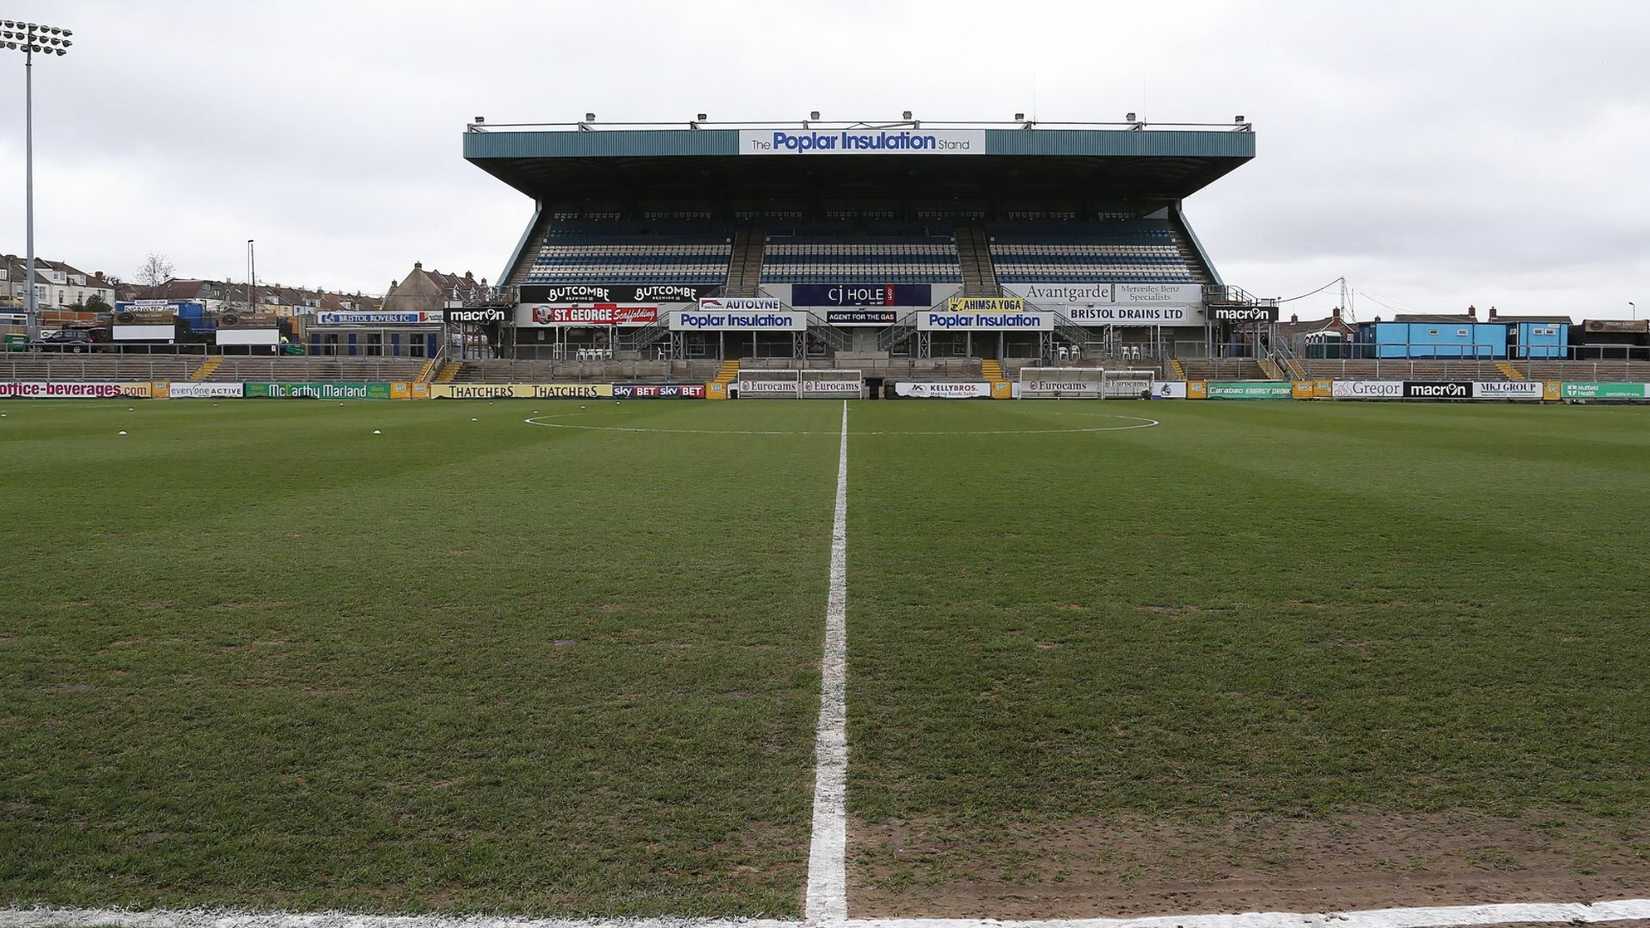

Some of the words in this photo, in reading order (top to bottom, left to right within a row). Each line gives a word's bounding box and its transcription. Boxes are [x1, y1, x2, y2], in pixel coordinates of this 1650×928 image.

[752, 139, 771, 150] The
[773, 131, 838, 153] Poplar
[841, 131, 936, 150] Insulation
[938, 139, 970, 150] Stand
[547, 286, 610, 302] BUTCOMBE
[634, 286, 697, 302] BUTCOMBE
[847, 288, 884, 301] HOLE
[1026, 285, 1109, 300] Avantgarde
[726, 300, 779, 310] AUTOLYNE
[963, 299, 997, 310] AHIMSA
[999, 299, 1021, 310] YOGA
[450, 308, 505, 321] macron
[554, 309, 569, 321] ST.
[570, 309, 612, 321] GEORGE
[829, 313, 851, 321] AGENT
[852, 313, 866, 321] FOR
[867, 313, 880, 321] THE
[880, 313, 895, 321] GAS
[1070, 309, 1114, 319] BRISTOL
[1119, 309, 1160, 319] DRAINS
[1164, 309, 1183, 319] LTD
[1215, 307, 1269, 320] macron
[680, 313, 725, 329] Poplar
[728, 313, 793, 327] Insulation
[929, 313, 973, 329] Poplar
[976, 313, 1040, 327] Insulation
[322, 384, 367, 397] Marland
[449, 385, 514, 397] THATCHERS
[532, 385, 597, 397] THATCHERS
[614, 386, 632, 396] sky
[637, 387, 656, 396] BET
[682, 387, 702, 396] BET
[751, 382, 797, 391] Eurocams
[814, 382, 859, 391] Eurocams
[1039, 381, 1087, 391] Eurocams
[1352, 382, 1400, 397] Gregor
[1410, 383, 1466, 396] macron
[1481, 383, 1501, 391] MKJ
[1503, 383, 1536, 391] GROUP
